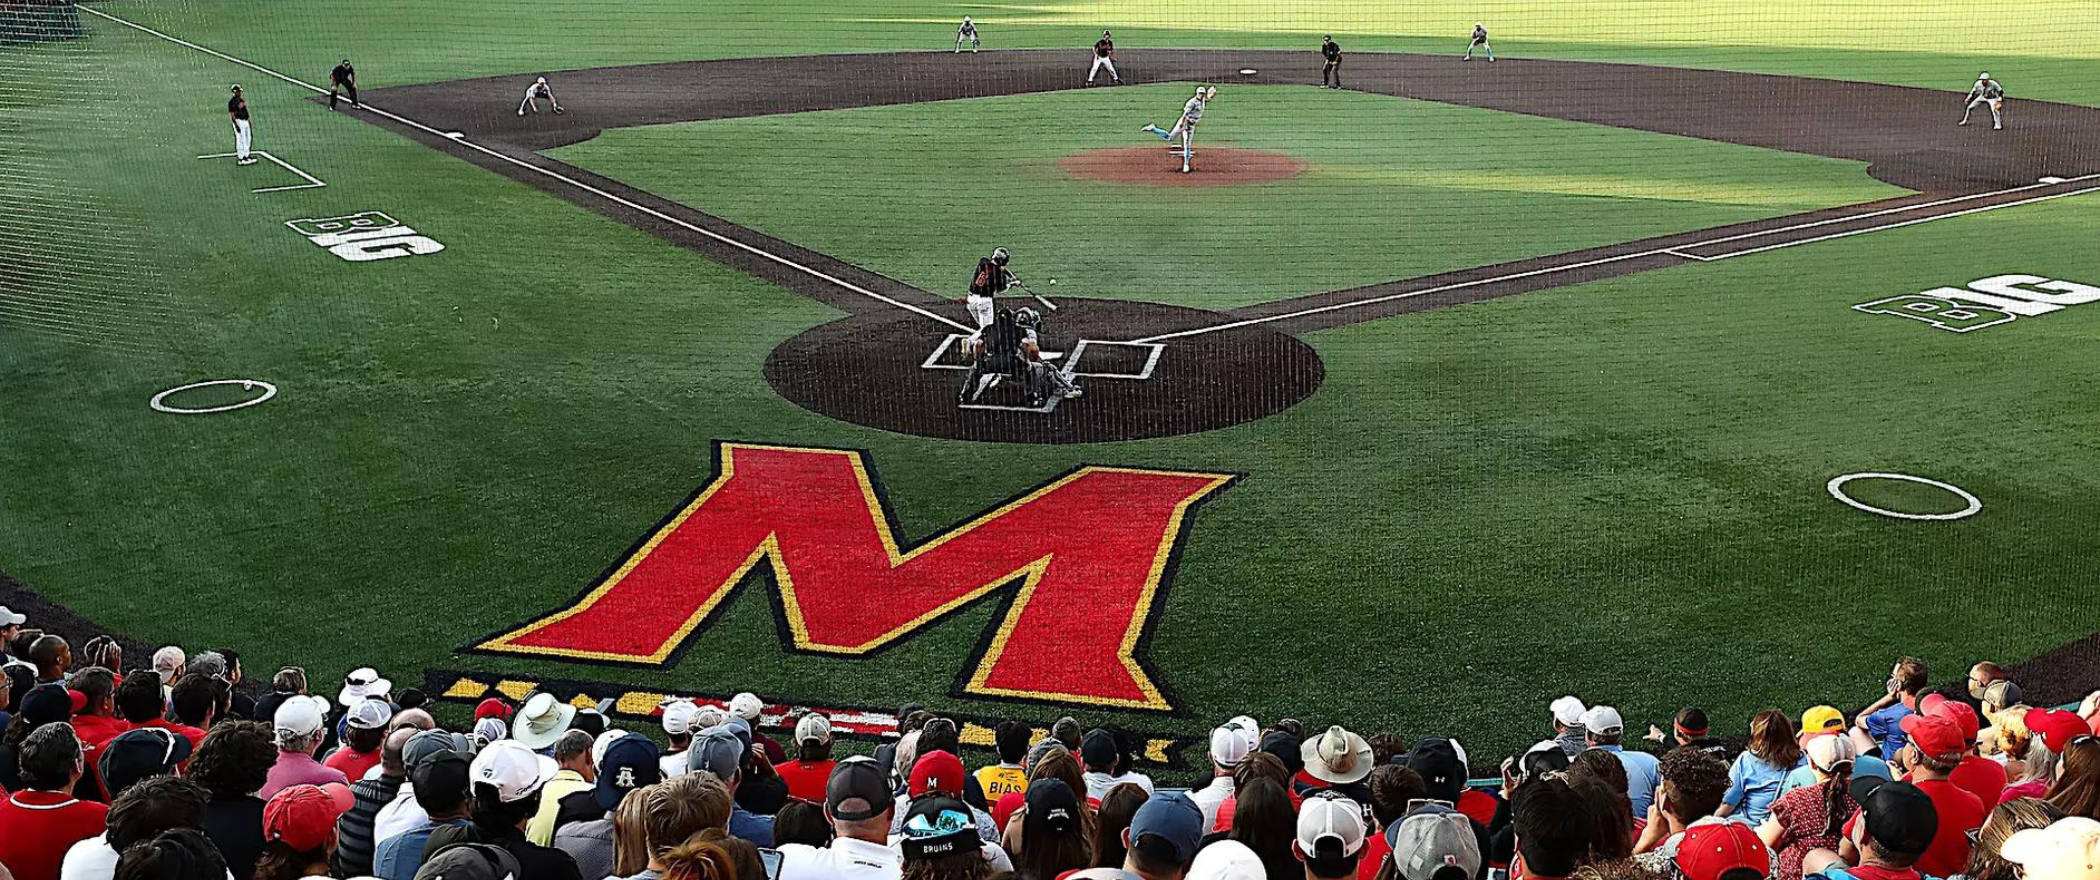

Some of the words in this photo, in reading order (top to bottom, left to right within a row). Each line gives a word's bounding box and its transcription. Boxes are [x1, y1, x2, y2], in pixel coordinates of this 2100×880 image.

[473, 440, 1240, 711] M
[926, 776, 938, 789] M
[923, 841, 953, 854] BRUINS
